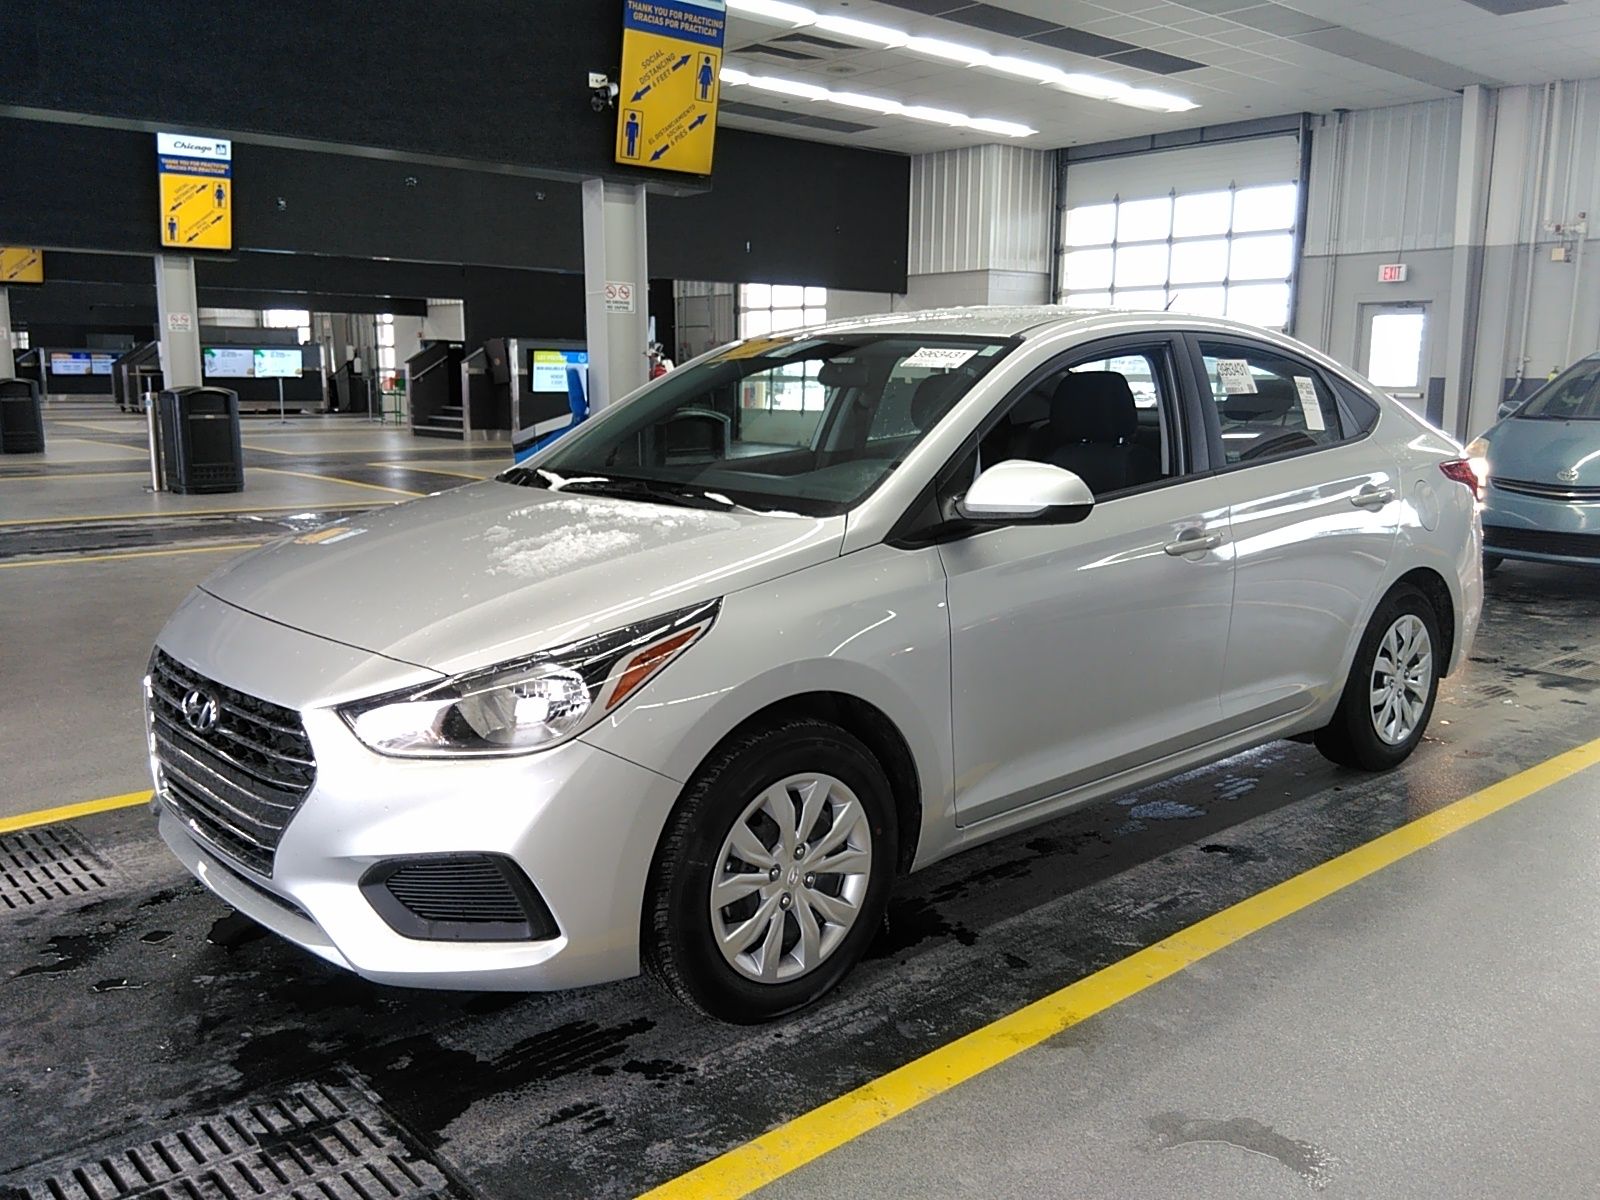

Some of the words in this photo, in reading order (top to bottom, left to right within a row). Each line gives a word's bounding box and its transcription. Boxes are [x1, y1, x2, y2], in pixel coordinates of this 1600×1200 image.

[628, 1, 653, 13] THANK
[654, 6, 669, 17] YOU
[669, 9, 683, 20] FOR
[684, 12, 723, 28] PRACTICING
[633, 11, 664, 26] GRACIAS
[664, 18, 680, 29] POR
[680, 22, 718, 37] PRACTICAR
[639, 52, 676, 85] DISTANCING
[641, 49, 664, 69] SOCIAL
[656, 69, 671, 84] FEET
[173, 141, 212, 153] Chicago
[1384, 266, 1402, 280] EXIT
